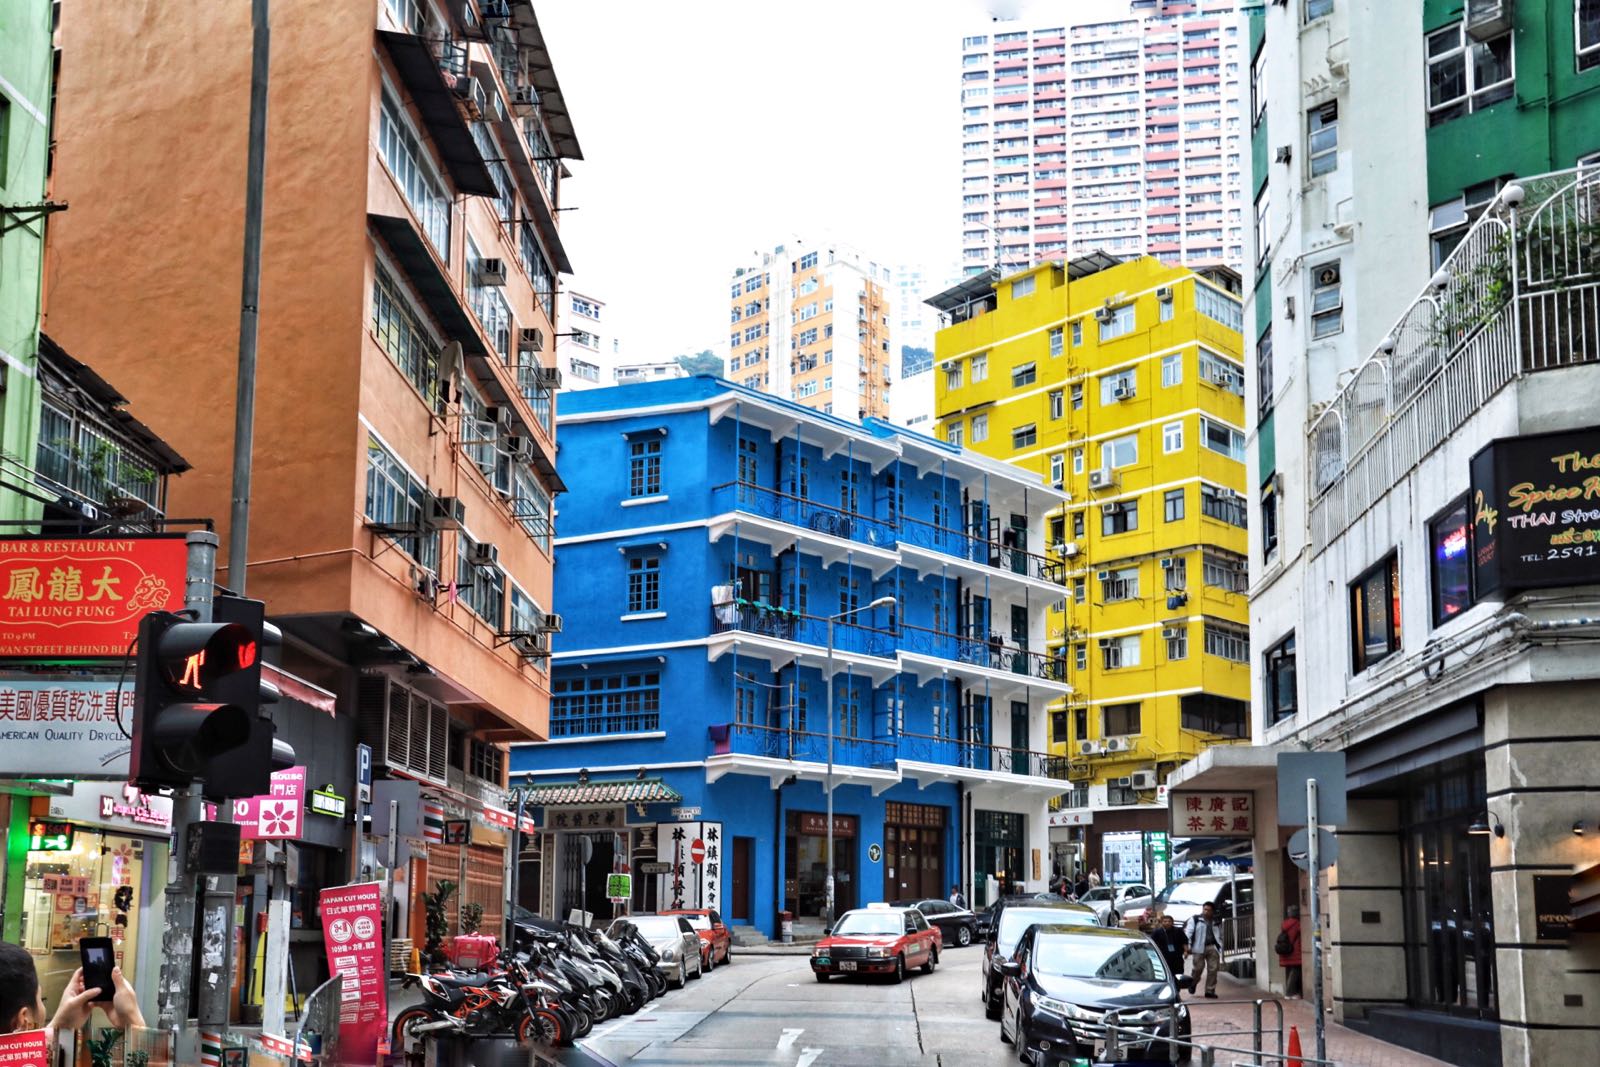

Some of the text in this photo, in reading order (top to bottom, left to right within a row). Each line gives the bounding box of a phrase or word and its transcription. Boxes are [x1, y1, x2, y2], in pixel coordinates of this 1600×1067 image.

[1551, 451, 1600, 473] The
[1508, 482, 1582, 511] Spice
[1507, 512, 1556, 528] THAI
[0, 541, 135, 552] BAR & RESTAURANT
[1520, 545, 1597, 562] TEL: 2591
[8, 606, 115, 616] TAI LUNG FUNG
[24, 645, 62, 654] STREET
[66, 645, 108, 654] BEHIND
[45, 728, 83, 740] QUALITY
[361, 749, 369, 780] P
[270, 784, 297, 796] 門店
[1185, 815, 1250, 832] 茶餐廳
[323, 896, 343, 904] JAPAN
[9, 1042, 22, 1050] CUT
[23, 1040, 43, 1048] HOUSE
